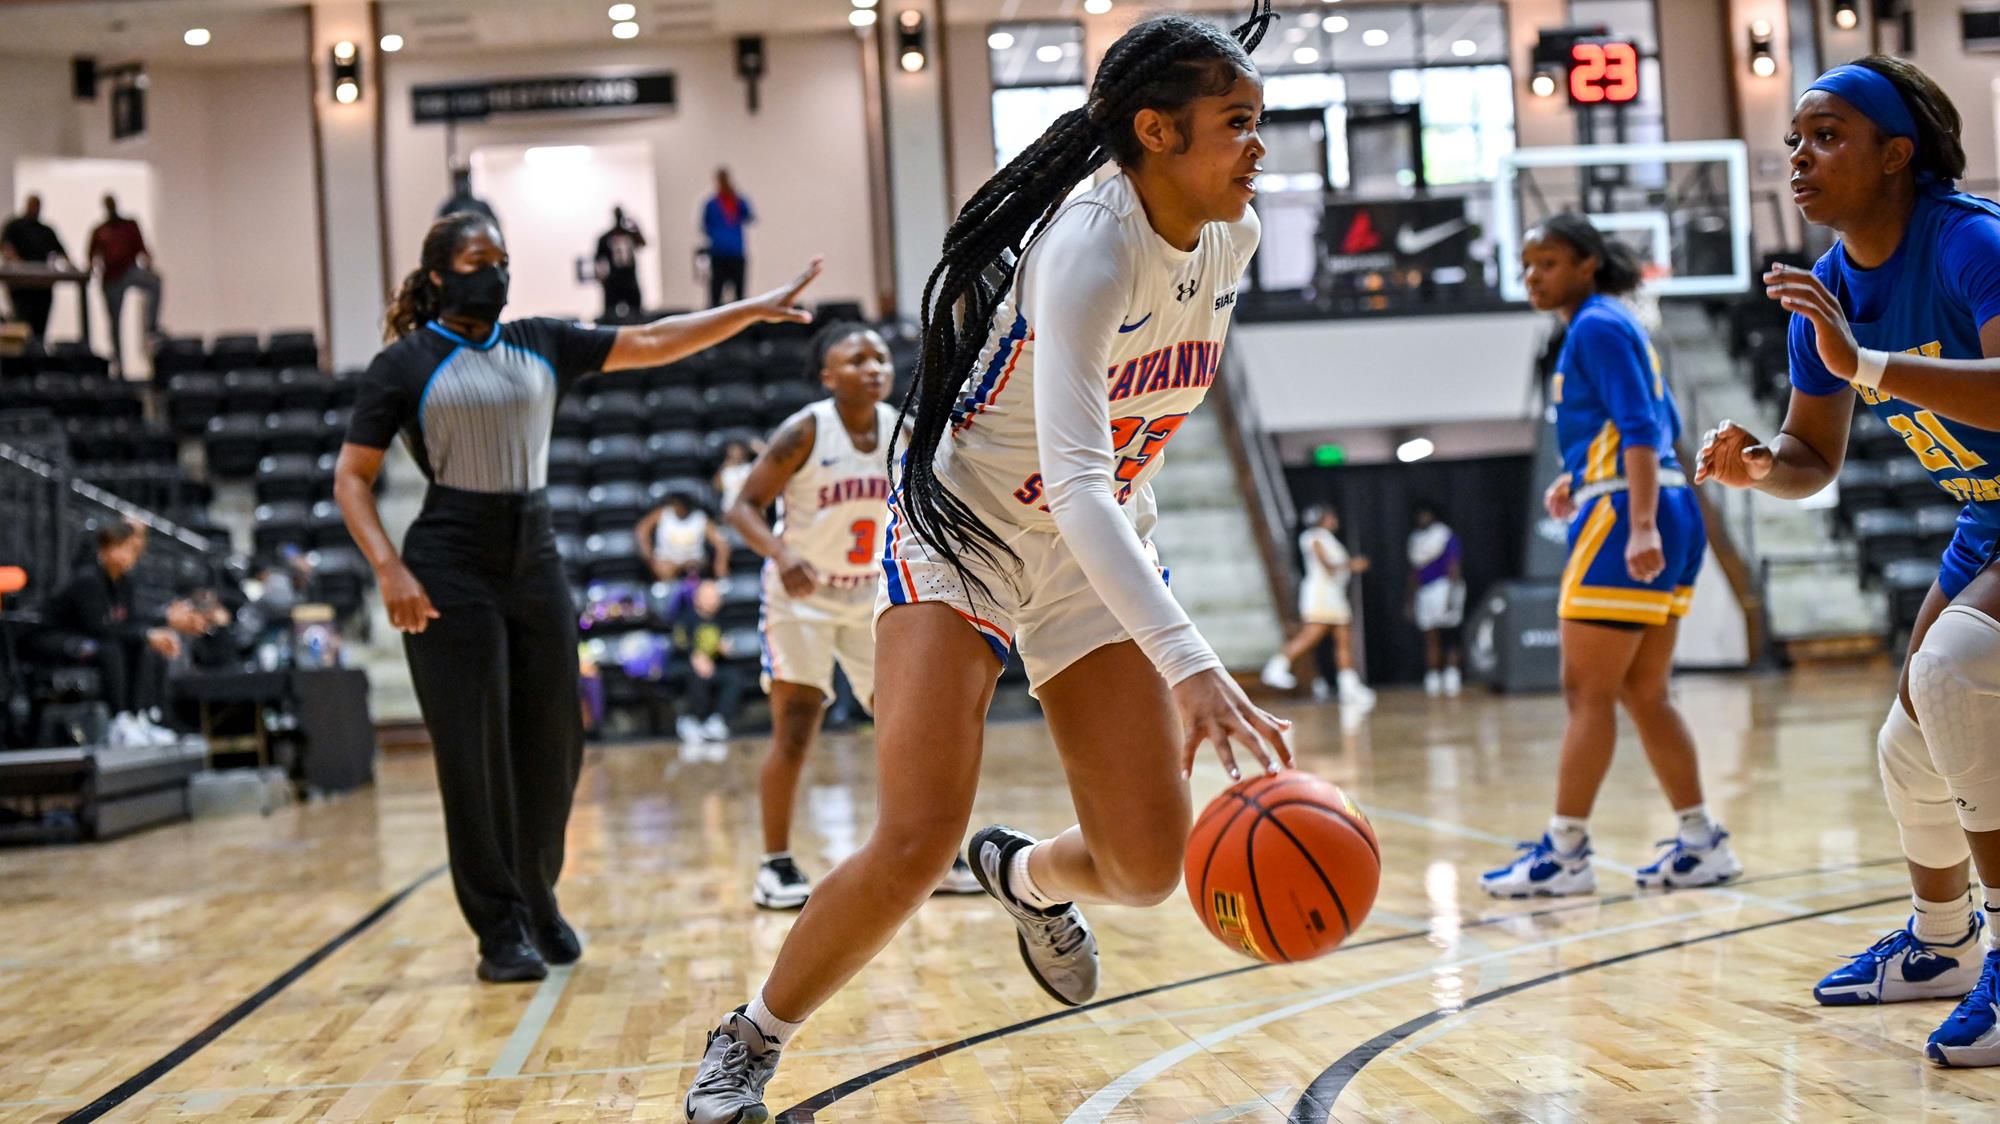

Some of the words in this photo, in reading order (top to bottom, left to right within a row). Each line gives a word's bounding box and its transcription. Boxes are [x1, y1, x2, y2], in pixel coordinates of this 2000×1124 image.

[1571, 43, 1638, 102] 23
[1214, 291, 1235, 311] SIAC
[1107, 340, 1223, 402] AVANNA
[1887, 409, 1989, 472] 21
[847, 519, 876, 565] 3
